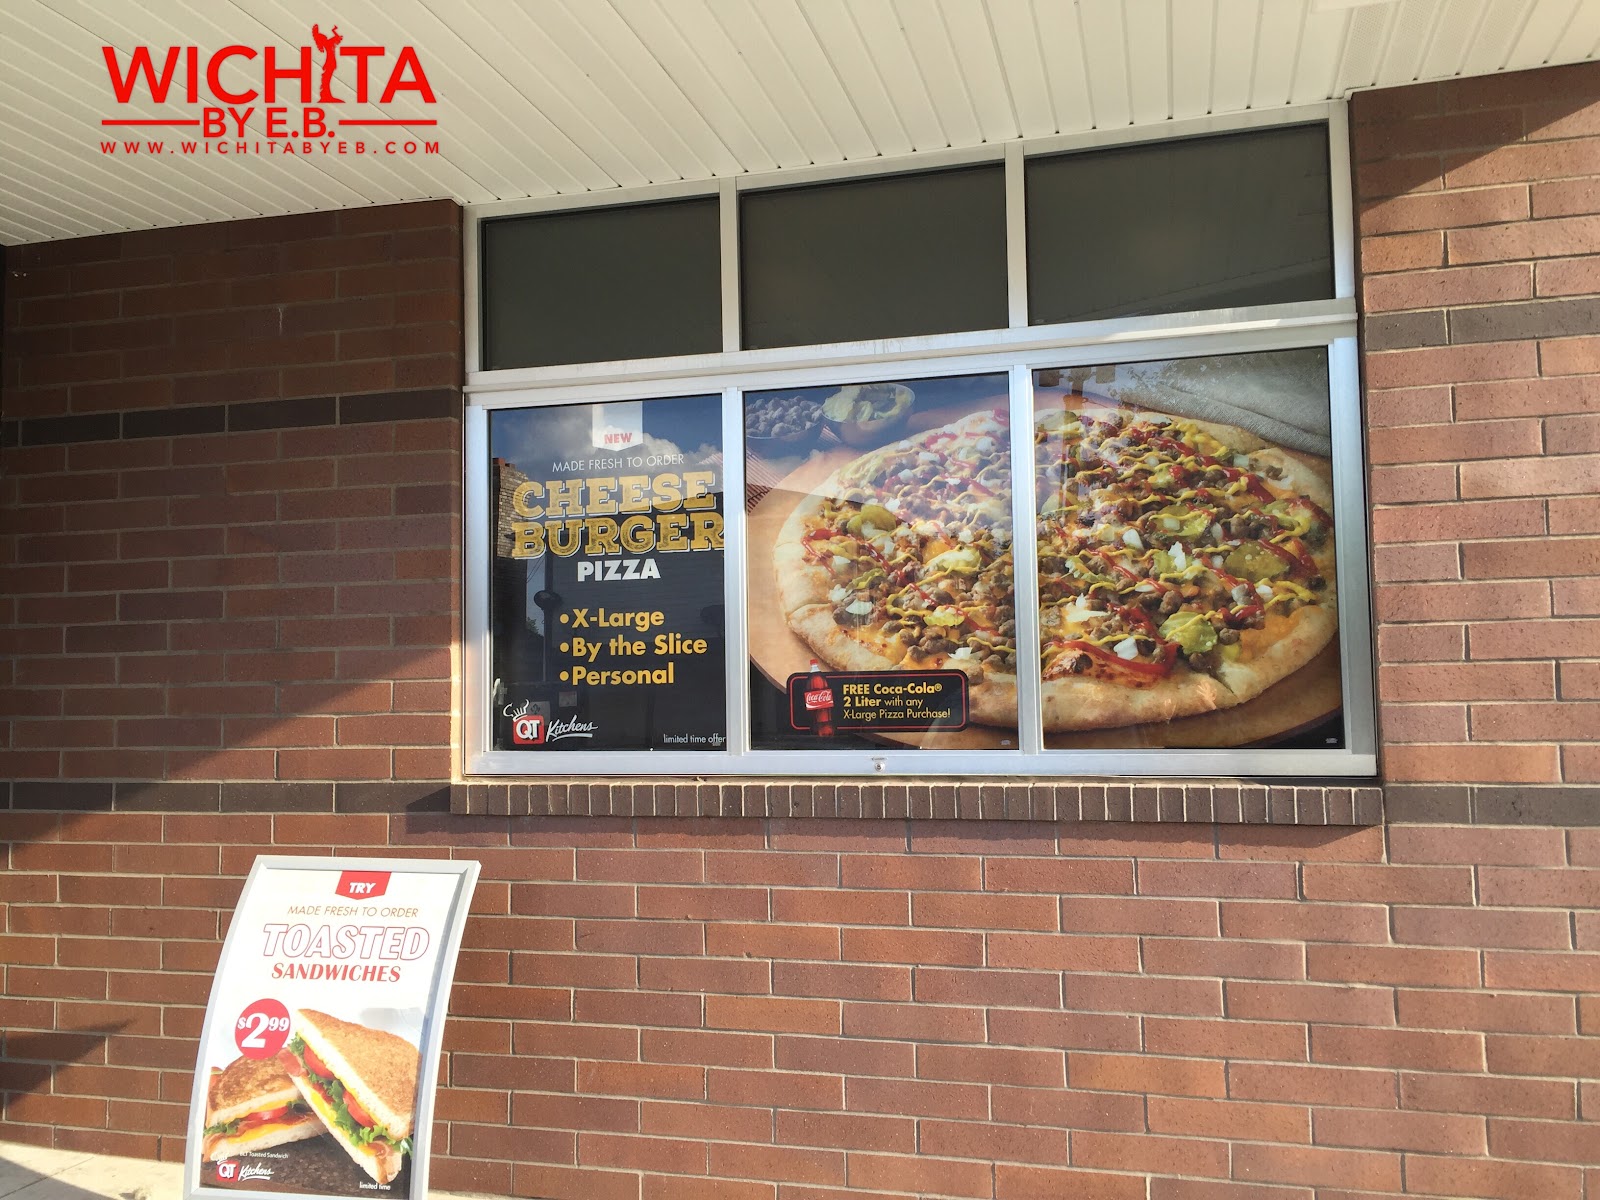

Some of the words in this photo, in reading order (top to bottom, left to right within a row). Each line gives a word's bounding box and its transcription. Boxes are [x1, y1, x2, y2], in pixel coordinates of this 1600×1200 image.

[604, 432, 633, 444] NEW
[552, 460, 585, 473] MADE
[588, 457, 623, 470] FRESH
[626, 456, 643, 468] TO
[646, 453, 684, 467] ORDER
[512, 471, 716, 520] CHEESE
[511, 511, 724, 560] BURGER
[577, 558, 661, 582] PIZZA
[571, 607, 665, 632] X-Large
[572, 637, 602, 662] By
[609, 634, 647, 656] the
[654, 632, 708, 655] Slice
[572, 661, 675, 685] Personal
[843, 684, 870, 695] FREE
[843, 696, 851, 707] 2
[855, 695, 882, 707] Liter
[884, 695, 903, 707] with
[906, 699, 924, 709] any
[843, 709, 877, 722] X-Large
[879, 708, 905, 719] Pizza
[906, 706, 951, 719] Purchase!
[516, 719, 540, 740] QT
[545, 714, 599, 742] Kitchens
[663, 733, 689, 743] limited
[690, 734, 707, 743] time
[708, 732, 727, 743] offer
[349, 882, 376, 894] TRY
[287, 905, 321, 916] MADE
[324, 905, 358, 917] FRESH
[362, 906, 378, 917] TO
[380, 907, 419, 918] ORDER
[263, 923, 430, 961] TOASTED
[271, 962, 402, 983] SANDWICHES
[218, 1163, 236, 1179] QT
[238, 1162, 275, 1181] Kitchens
[359, 1181, 378, 1190] limited
